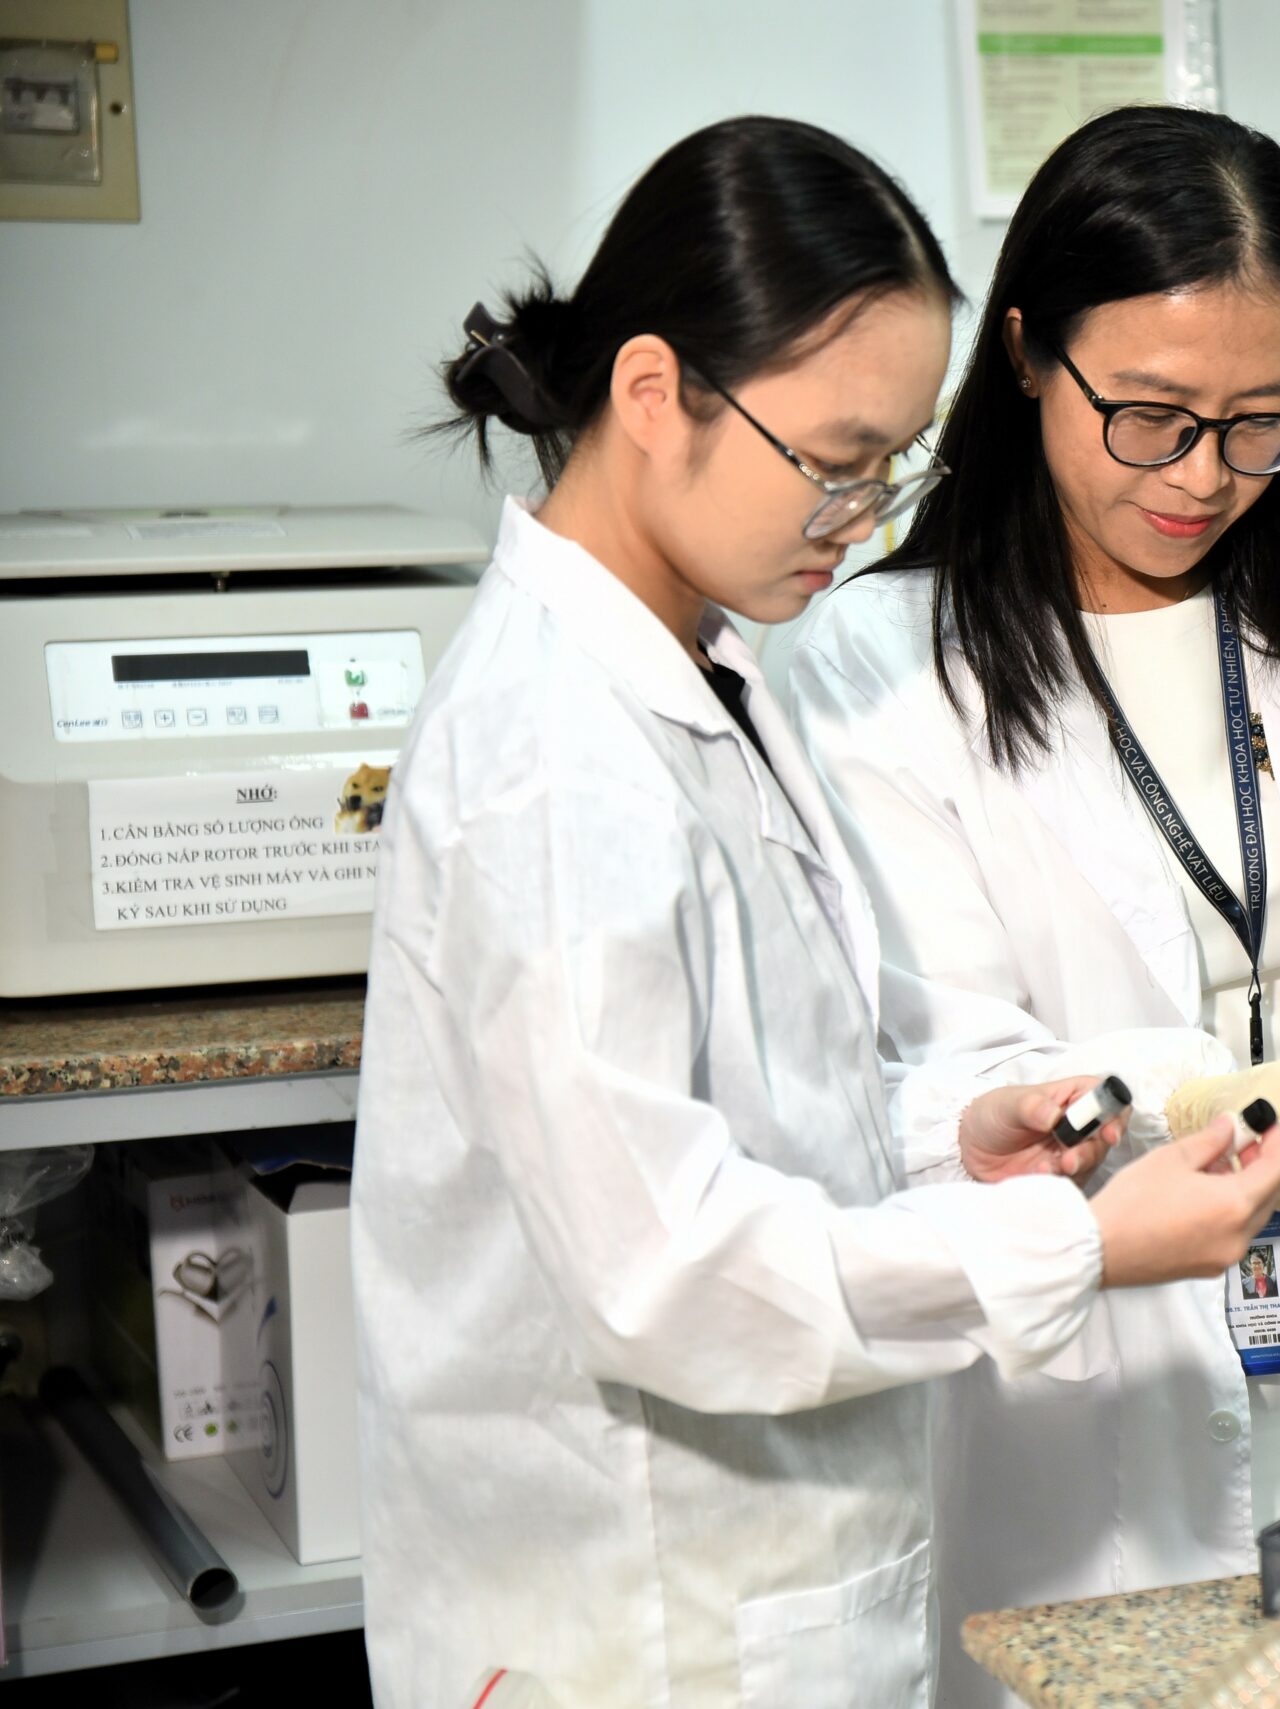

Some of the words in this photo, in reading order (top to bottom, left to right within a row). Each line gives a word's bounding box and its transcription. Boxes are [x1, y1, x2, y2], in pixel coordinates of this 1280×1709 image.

[1223, 637, 1238, 684] NHIÊN,
[1231, 710, 1246, 739] HỌC
[1234, 742, 1250, 783] KHOA
[236, 784, 278, 802] NHỚ:
[1240, 786, 1255, 817] HỌC
[228, 818, 285, 835] LƯỢNG
[1130, 755, 1147, 776] VÀ
[1140, 775, 1169, 814] CÔNG
[1162, 813, 1194, 853] NGHỆ
[1187, 850, 1209, 875] VẬT
[1202, 875, 1227, 901] LIỆU
[1244, 820, 1259, 844] ĐẠI
[115, 849, 162, 867] ĐÓNG
[204, 846, 258, 863] ROTOR
[263, 842, 317, 859] TRƯỚC
[322, 841, 349, 856] KHI
[353, 840, 383, 854] STA
[163, 877, 195, 891] TRA
[225, 872, 261, 888] SINH
[266, 867, 303, 884] MÁY
[308, 866, 330, 881] VÀ
[334, 866, 362, 880] GHI
[1246, 848, 1261, 912] TRƯỜNG
[145, 904, 178, 919] SAU
[183, 901, 211, 916] KHI
[241, 898, 288, 914] DỤNG
